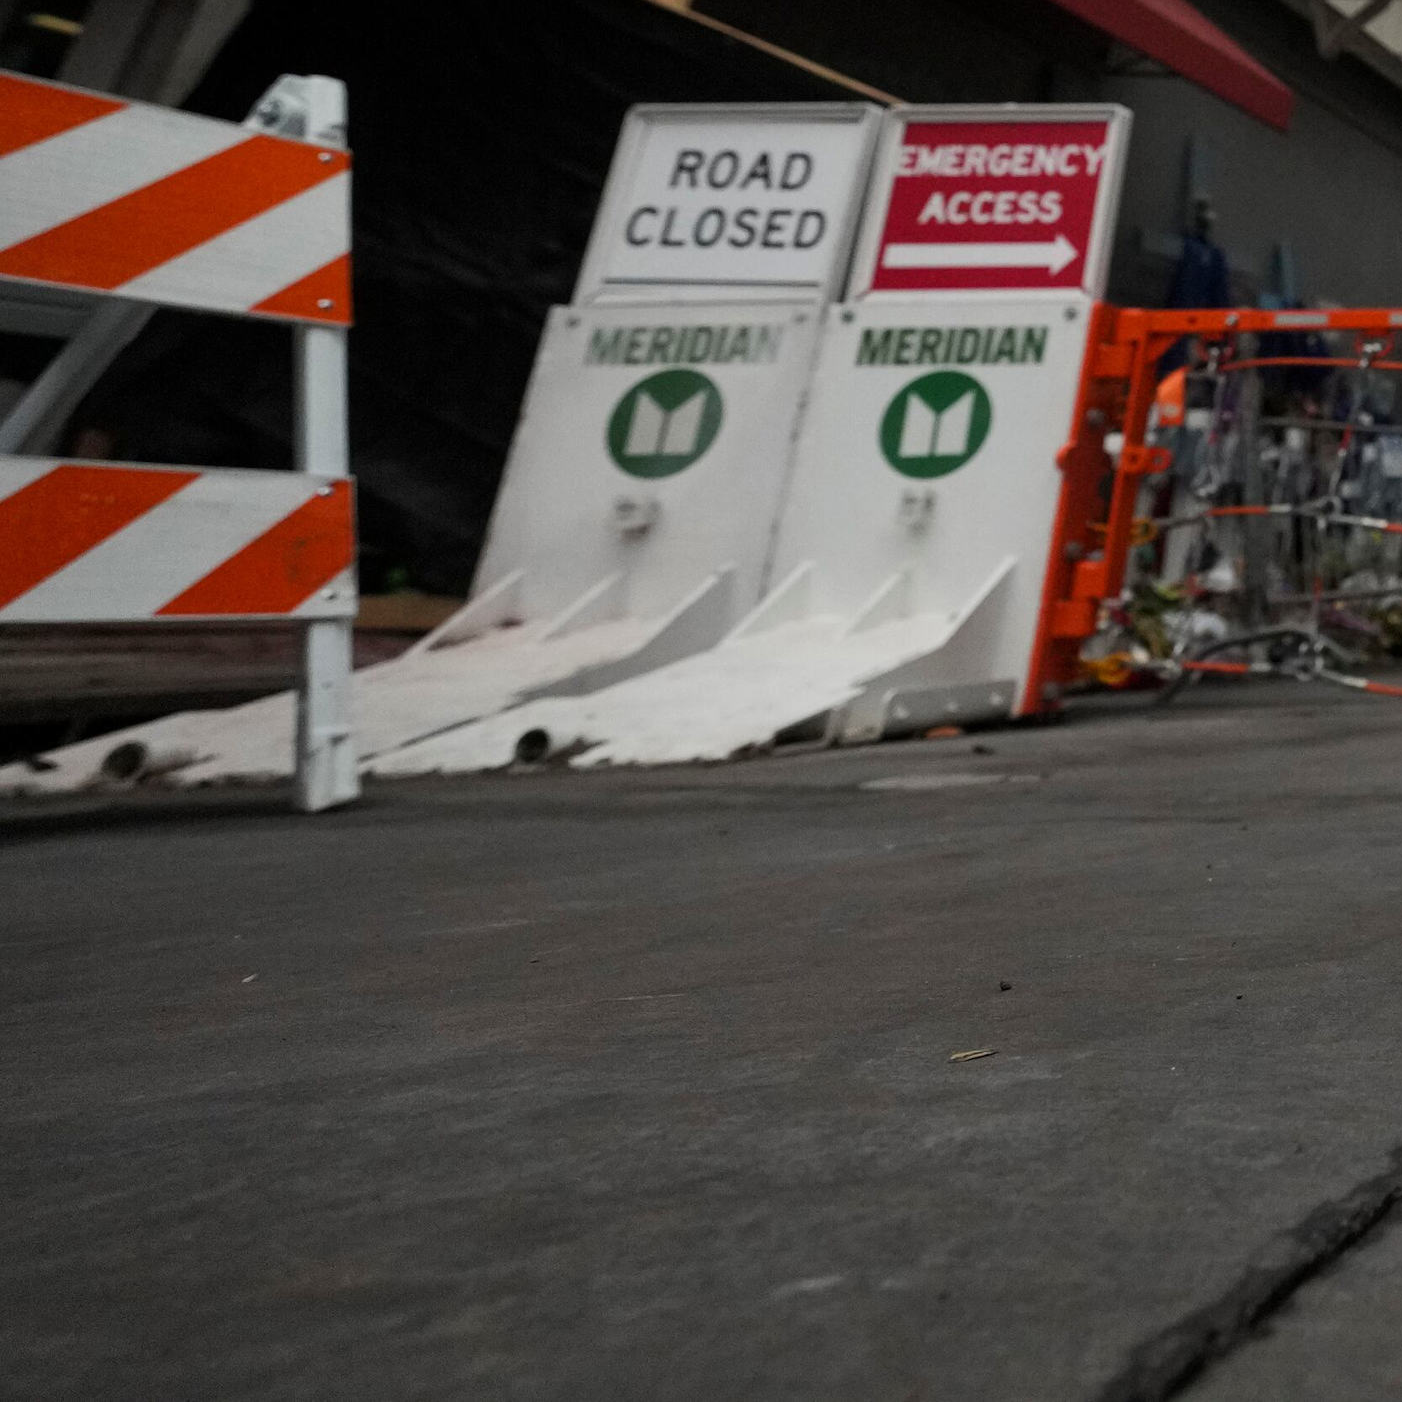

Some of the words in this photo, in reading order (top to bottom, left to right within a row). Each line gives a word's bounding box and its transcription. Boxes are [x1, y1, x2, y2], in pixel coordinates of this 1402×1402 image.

[669, 150, 814, 191] ROAD
[897, 144, 1108, 178] EMERGENCY
[624, 207, 828, 250] CLOSED
[918, 191, 1063, 225] ACCESS
[584, 325, 785, 367] MERIDIAN
[854, 326, 1050, 367] MERIDIAN
